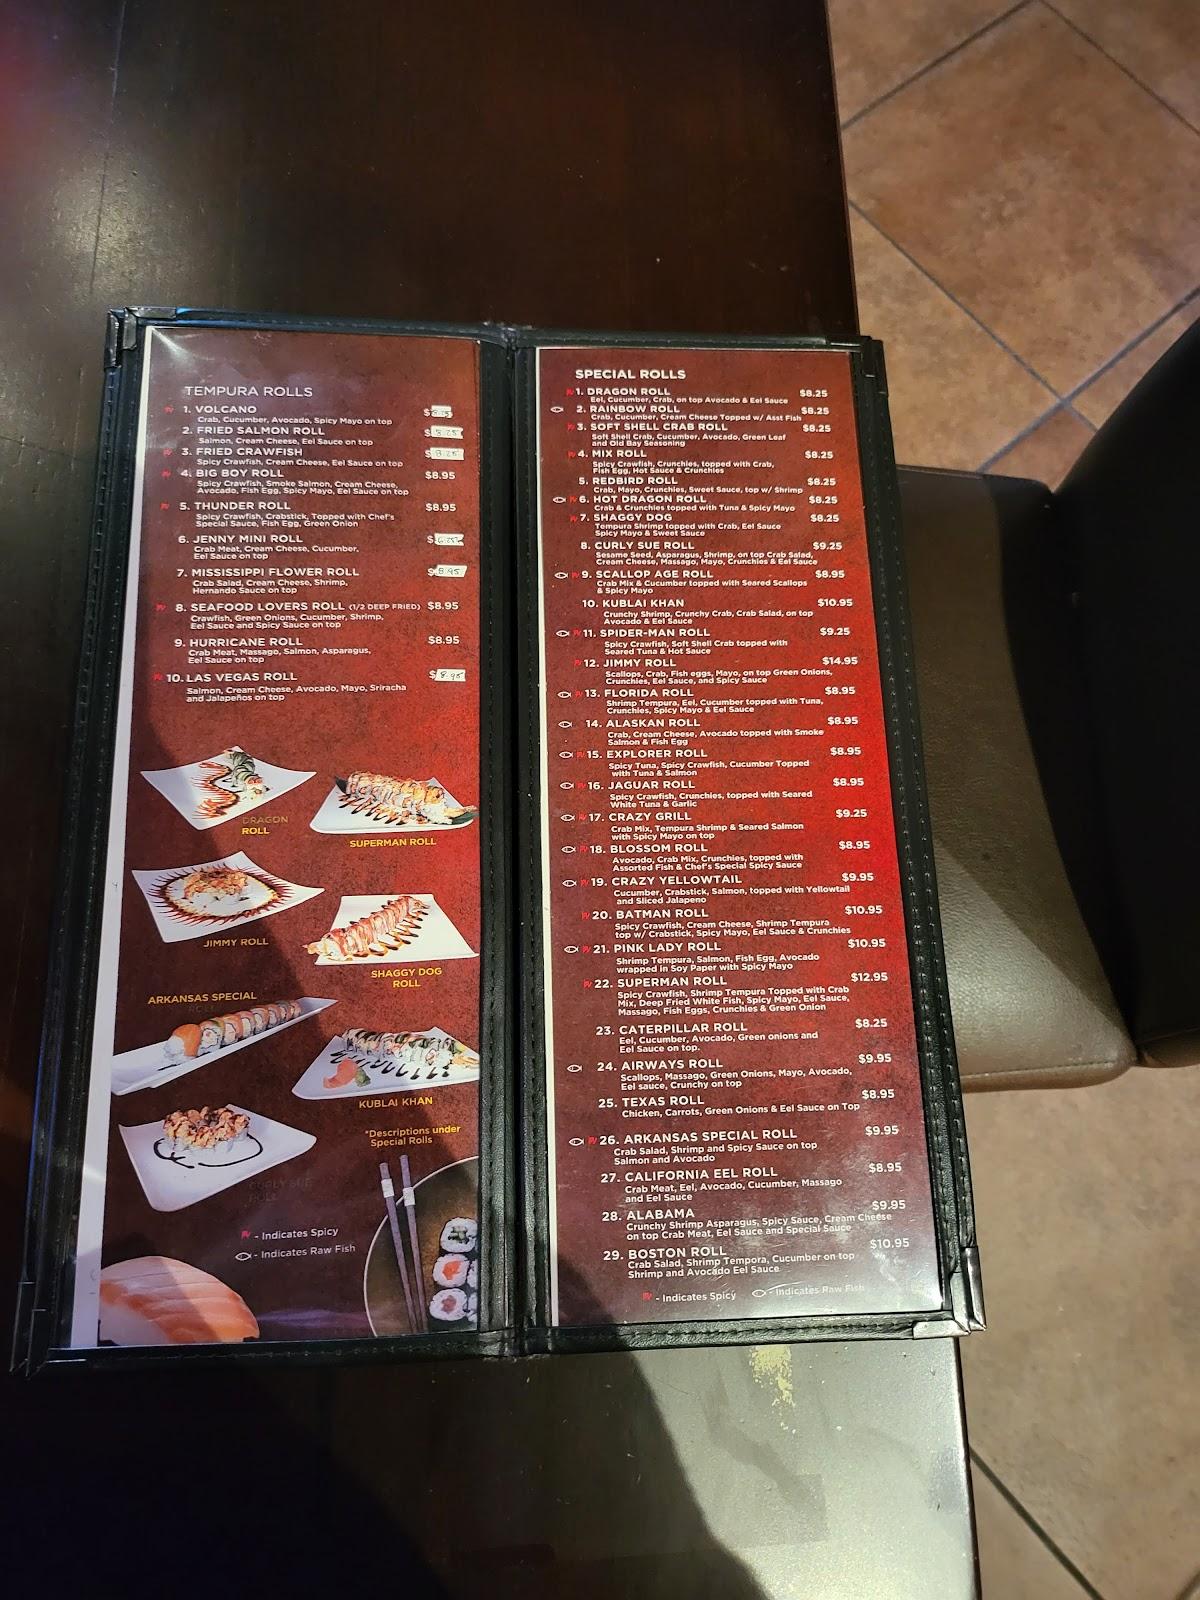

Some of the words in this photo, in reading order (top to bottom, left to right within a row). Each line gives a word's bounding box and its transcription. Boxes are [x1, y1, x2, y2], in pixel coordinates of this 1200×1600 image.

[575, 368, 636, 379] SPECIAL
[639, 368, 686, 379] ROLLS
[184, 385, 259, 396] TEMPURA
[263, 386, 313, 397] ROLLS
[575, 387, 584, 395] 1.
[586, 387, 637, 396] DRAGON
[640, 387, 671, 396] ROLL
[799, 388, 828, 397] $8.25
[182, 405, 191, 413] 1.
[194, 405, 257, 414] VOLCANO
[222, 415, 269, 423] Cucumber,
[270, 416, 312, 424] Avocado,
[313, 416, 338, 425] Spicy
[339, 417, 363, 425] Mayo
[376, 417, 392, 425] top
[181, 426, 193, 434] 2.
[196, 426, 233, 434] FRIED
[236, 426, 289, 435] SALMON
[292, 426, 325, 435] ROLL
[576, 422, 587, 431] 3.
[590, 422, 620, 431] SOFT
[623, 422, 659, 430] SHELL
[662, 422, 694, 430] CRAB
[697, 422, 728, 431] ROLL
[802, 423, 831, 433] $8.25
[181, 447, 192, 456] 3.
[195, 447, 233, 456] FRIED
[236, 447, 303, 456] CRAWFISH
[179, 468, 192, 477] 4.
[195, 468, 217, 477] BIG
[221, 468, 248, 477] BOY
[251, 468, 284, 477] ROLL
[424, 470, 456, 480] $8.95
[179, 501, 190, 510] 5.
[193, 501, 255, 510] THUNDER
[257, 501, 291, 510] ROLL
[425, 502, 456, 512] $8.95
[177, 534, 189, 544] 6.
[192, 534, 235, 543] JENNY
[238, 534, 266, 543] MINI
[269, 534, 303, 543] ROLL
[176, 568, 188, 577] 7.
[191, 567, 264, 577] MISSISSIPPI
[268, 567, 323, 576] FLOWER
[326, 567, 360, 576] ROLL
[191, 586, 237, 594] Hernando
[238, 586, 266, 594] Sauce
[280, 586, 297, 594] top
[174, 603, 187, 612] 8.
[190, 602, 253, 612] SEAFOOD
[256, 602, 308, 612] LOVERS
[314, 601, 345, 611] ROLL
[348, 603, 366, 611] (1/2
[367, 603, 390, 611] DEEP
[391, 603, 421, 611] FRIED)
[427, 600, 459, 610] $8.95
[582, 628, 596, 637] 11.
[599, 628, 675, 637] SPIDER-MAN
[678, 627, 710, 637] ROLL
[819, 626, 851, 636] $9.25
[173, 638, 186, 647] 9.
[189, 637, 265, 647] HURRICANE
[269, 637, 303, 646] ROLL
[427, 635, 460, 645] $8.95
[165, 673, 184, 683] 10.
[185, 673, 211, 683] LAS
[214, 672, 259, 682] VEGAS
[263, 671, 297, 681] ROLL
[185, 694, 204, 702] and
[205, 693, 252, 702] Jalapeños
[267, 693, 285, 701] top
[586, 749, 602, 759] 15.
[606, 749, 671, 759] EXPLORER
[675, 748, 708, 758] ROLL
[829, 746, 861, 756] $8.95
[609, 800, 637, 808] White
[638, 800, 661, 808] Tuna
[671, 799, 697, 807] Garlic
[242, 815, 288, 824] DRAGON
[241, 826, 270, 835] ROLL
[349, 838, 407, 848] SUPERMAN
[409, 837, 437, 846] ROLL
[590, 877, 607, 887] 19.
[611, 876, 655, 886] CRAZY
[658, 874, 742, 885] YELLOWTAIL
[841, 871, 874, 882] $9.95
[591, 910, 612, 920] 20.
[615, 908, 671, 919] BATMAN
[674, 908, 709, 918] ROLL
[844, 904, 883, 915] $10.95
[203, 938, 237, 947] JIMMY
[240, 937, 269, 946] ROLL
[370, 968, 416, 978] SHAGGY
[418, 966, 442, 976] DOG
[850, 971, 888, 982] $12.95
[392, 978, 421, 988] ROLL
[594, 978, 613, 989] 22.
[617, 976, 689, 988] SUPERMAN
[693, 975, 727, 986] ROLL
[147, 993, 209, 1004] ARKANSAS
[211, 991, 257, 1001] SPECIAL
[595, 1025, 615, 1035] 23.
[618, 1022, 709, 1035] CATERPILLAR
[713, 1021, 748, 1032] ROLL
[854, 1017, 888, 1029] $8.25
[858, 1052, 892, 1064] $9.95
[596, 1061, 617, 1072] 24.
[620, 1059, 684, 1071] AIRWAYS
[688, 1058, 723, 1068] ROLL
[620, 1073, 663, 1082] Scallops,
[664, 1072, 708, 1081] Massago,
[709, 1070, 738, 1079] Green
[740, 1069, 776, 1078] Onions,
[777, 1068, 806, 1078] Mayo,
[807, 1066, 852, 1075] Avocado,
[861, 1088, 895, 1100] $8.95
[358, 1098, 398, 1108] KUBLAI
[401, 1096, 433, 1106] KHAN
[597, 1097, 618, 1108] 25.
[621, 1096, 665, 1107] TEXAS
[669, 1095, 705, 1105] ROLL
[431, 1124, 461, 1134] under
[864, 1124, 900, 1136] $9.95
[370, 1136, 406, 1148] Special
[408, 1135, 433, 1145] Rolls
[599, 1134, 619, 1145] 26.
[623, 1131, 698, 1144] ARKANSAS
[701, 1129, 758, 1141] SPECIAL
[762, 1128, 797, 1139] ROLL
[867, 1161, 902, 1173] $8.95
[600, 1172, 620, 1183] 27.
[624, 1169, 709, 1182] CALIFORNIA
[713, 1167, 739, 1179] EEL
[742, 1166, 778, 1177] ROLL
[869, 1199, 906, 1211] $9.95
[601, 1210, 622, 1221] 28.
[626, 1207, 695, 1220] ALABAMA
[261, 1230, 308, 1240] Indicates
[310, 1227, 338, 1237] Spicy
[869, 1237, 910, 1249] $10.95
[602, 1249, 624, 1261] 29.
[628, 1247, 686, 1260] BOSTON
[690, 1245, 727, 1257] ROLL
